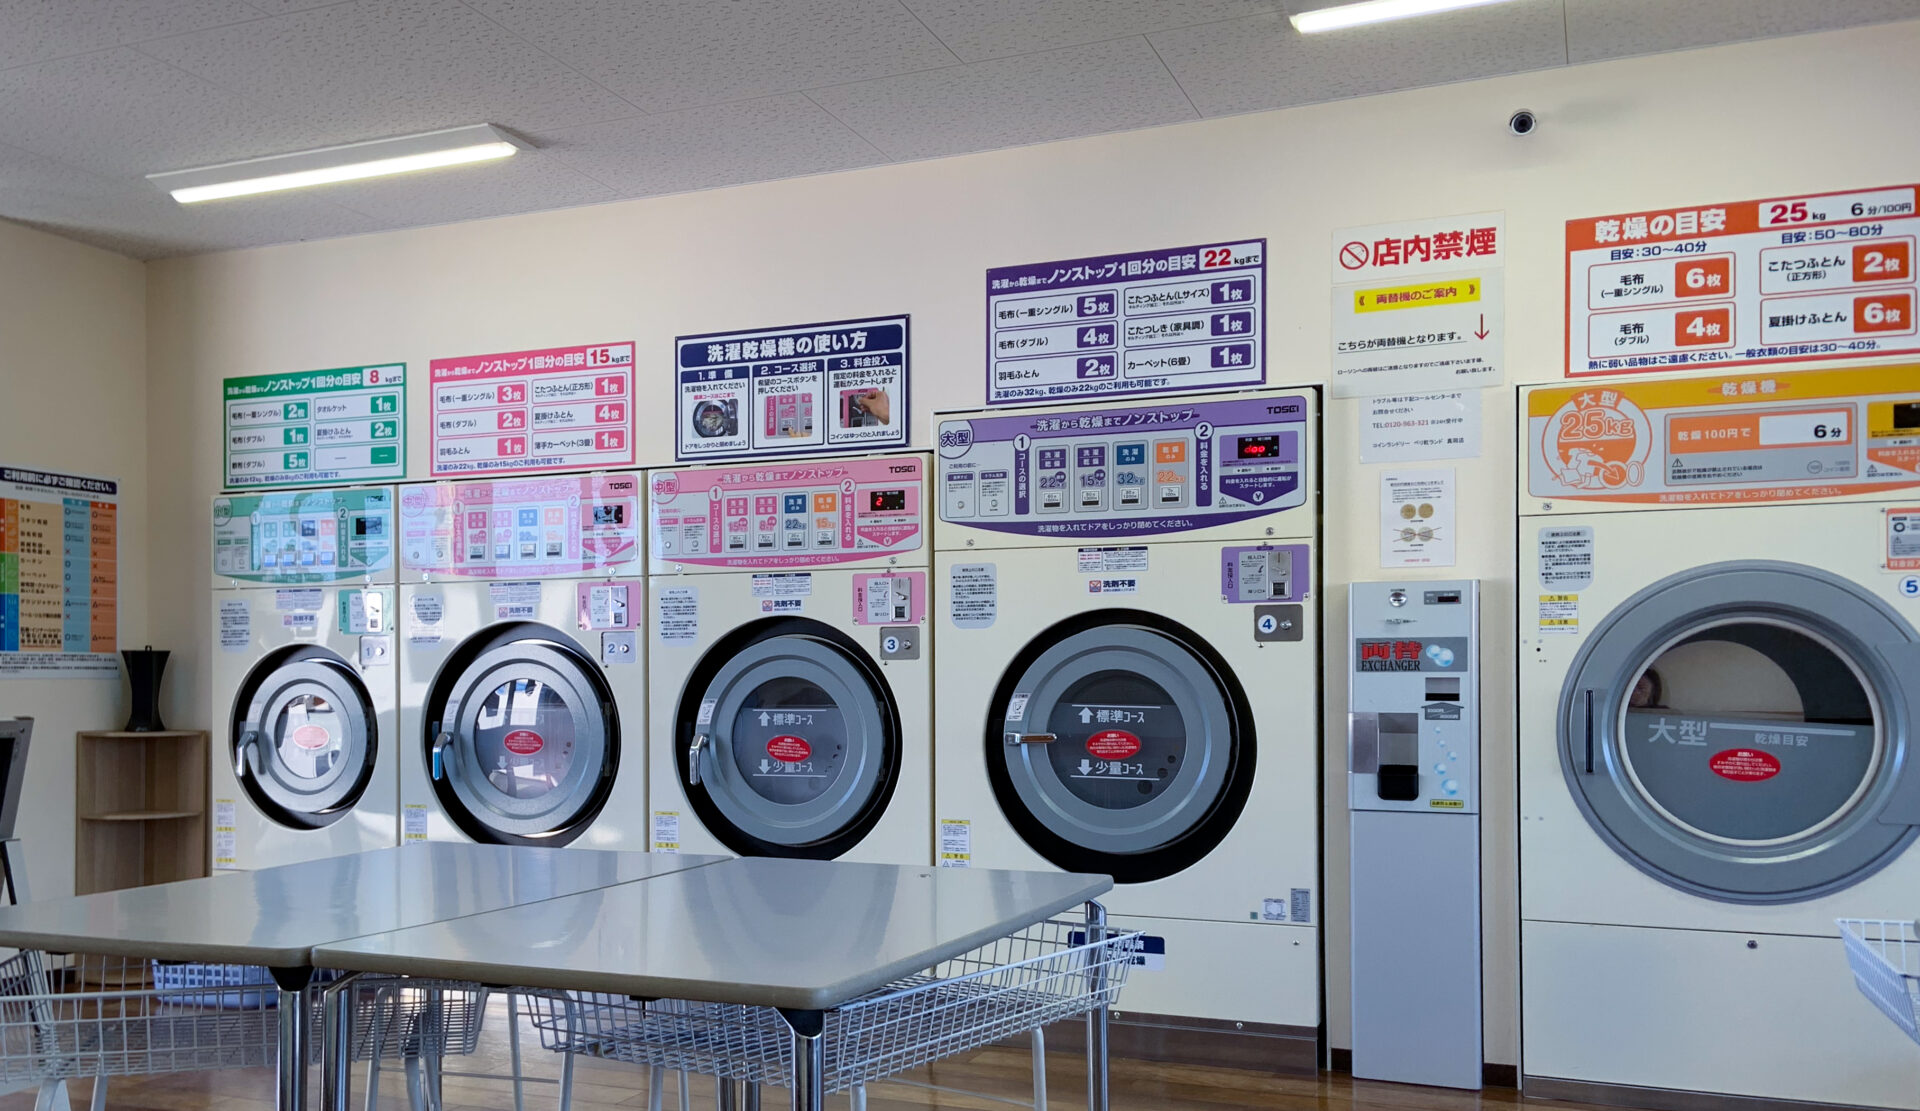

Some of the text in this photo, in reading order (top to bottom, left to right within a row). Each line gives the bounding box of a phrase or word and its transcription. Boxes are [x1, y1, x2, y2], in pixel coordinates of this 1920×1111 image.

[1595, 208, 1726, 243] 乾燥の目安
[1770, 203, 1808, 224] 25
[1812, 212, 1825, 222] kg
[1852, 203, 1864, 216] 6
[1372, 227, 1497, 267] 店内禁煙
[992, 249, 1259, 289] 洗濯から乾燥までノンストップ1回分の目安 22 kgまで
[1768, 257, 1845, 272] こたつふとん
[1864, 251, 1900, 274] 2枚
[1620, 274, 1644, 286] 毛布
[1686, 268, 1720, 288] 6枚
[1219, 283, 1242, 301] 1枚
[1377, 287, 1457, 304] 両替機のご案内
[1084, 298, 1110, 315] 5枚
[1864, 304, 1900, 323] 6枚
[1219, 315, 1242, 333] 1枚
[1687, 317, 1720, 337] 4枚
[1769, 313, 1847, 328] 夏掛けふとん
[1620, 323, 1644, 334] 毛布
[1083, 328, 1109, 345] 4枚
[1338, 332, 1462, 351] こちらが両替機となります。
[708, 331, 868, 362] 洗濯乾燥機の使い方
[590, 349, 609, 364] 15
[611, 355, 630, 363] kgまで
[854, 356, 889, 366] 料金投入
[1219, 348, 1242, 366] 1枚
[775, 363, 817, 374] コース選択
[834, 368, 897, 380] 指定の料金を入れると
[999, 369, 1039, 380] 羽毛ふとん
[1085, 359, 1110, 377] 2枚
[369, 370, 379, 383] 8
[758, 375, 817, 386] 希望のコースボタンを
[834, 377, 894, 388] 運転がスタートします
[601, 379, 618, 393] 1枚
[685, 382, 745, 393] 洗濯物を入れてください
[758, 385, 799, 394] 押してください
[1722, 380, 1776, 396] 乾燥機
[502, 387, 521, 401] 3枚
[1578, 391, 1618, 408] 大型
[288, 404, 305, 418] 2枚
[376, 398, 391, 412] 1枚
[1266, 405, 1299, 414] TOSEI
[599, 406, 620, 420] 4枚
[502, 414, 521, 427] 2枚
[1036, 410, 1194, 432] 洗濯から乾燥までノンストップ
[1561, 410, 1634, 440] 25kg
[290, 429, 304, 443] 1枚
[374, 423, 392, 436] 2枚
[1200, 425, 1208, 437] 2
[1814, 425, 1826, 438] 6
[1831, 428, 1842, 438] 分
[601, 433, 618, 447] 1枚
[941, 430, 970, 447] 大型
[504, 440, 521, 454] 1枚
[288, 454, 305, 468] 5枚
[714, 488, 718, 499] 1
[844, 482, 852, 492] 2
[340, 509, 346, 518] 2
[1906, 581, 1918, 593] 5
[1263, 619, 1272, 629] 4
[608, 644, 615, 653] 2
[888, 639, 895, 650] 3
[1361, 641, 1423, 660] 両替
[1362, 660, 1421, 671] EXCHANGER
[773, 713, 813, 725] 標準コース
[1096, 710, 1144, 723] 標準コース
[1649, 719, 1708, 746] 大型
[1754, 734, 1808, 746] 乾燥目安
[773, 761, 813, 773] 少量コース
[1096, 761, 1143, 775] 少量コース
